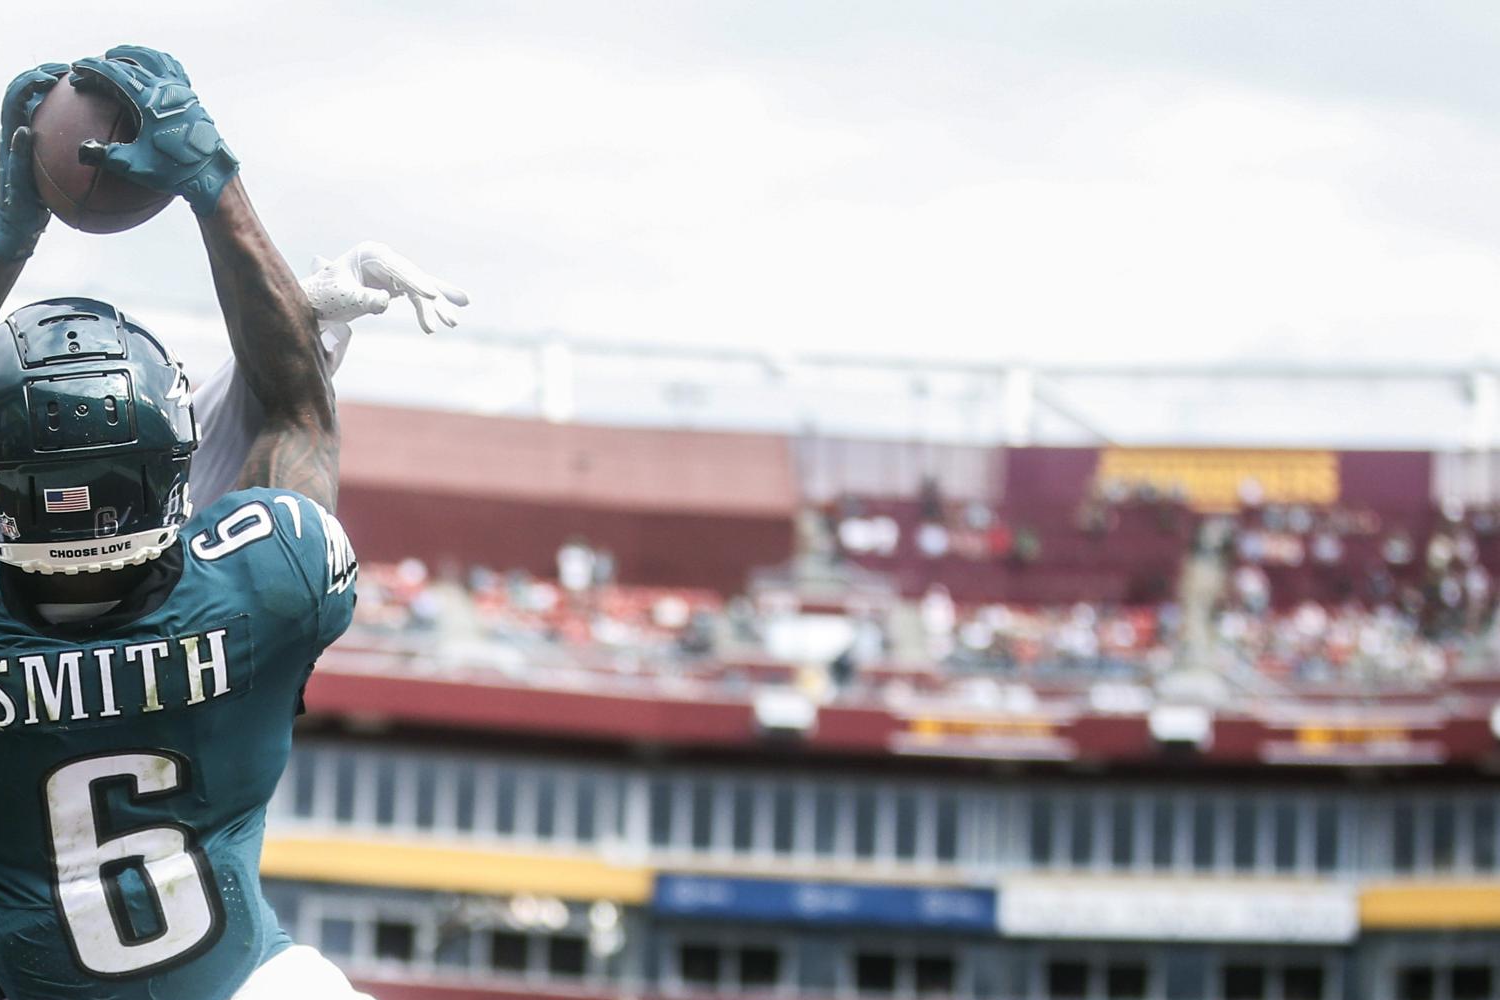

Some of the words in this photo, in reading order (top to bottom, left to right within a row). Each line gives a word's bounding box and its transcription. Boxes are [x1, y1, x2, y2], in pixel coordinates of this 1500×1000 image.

[50, 548, 98, 558] CHOOSE
[101, 541, 131, 555] LOVE
[190, 501, 274, 561] 6
[41, 749, 222, 980] 6
